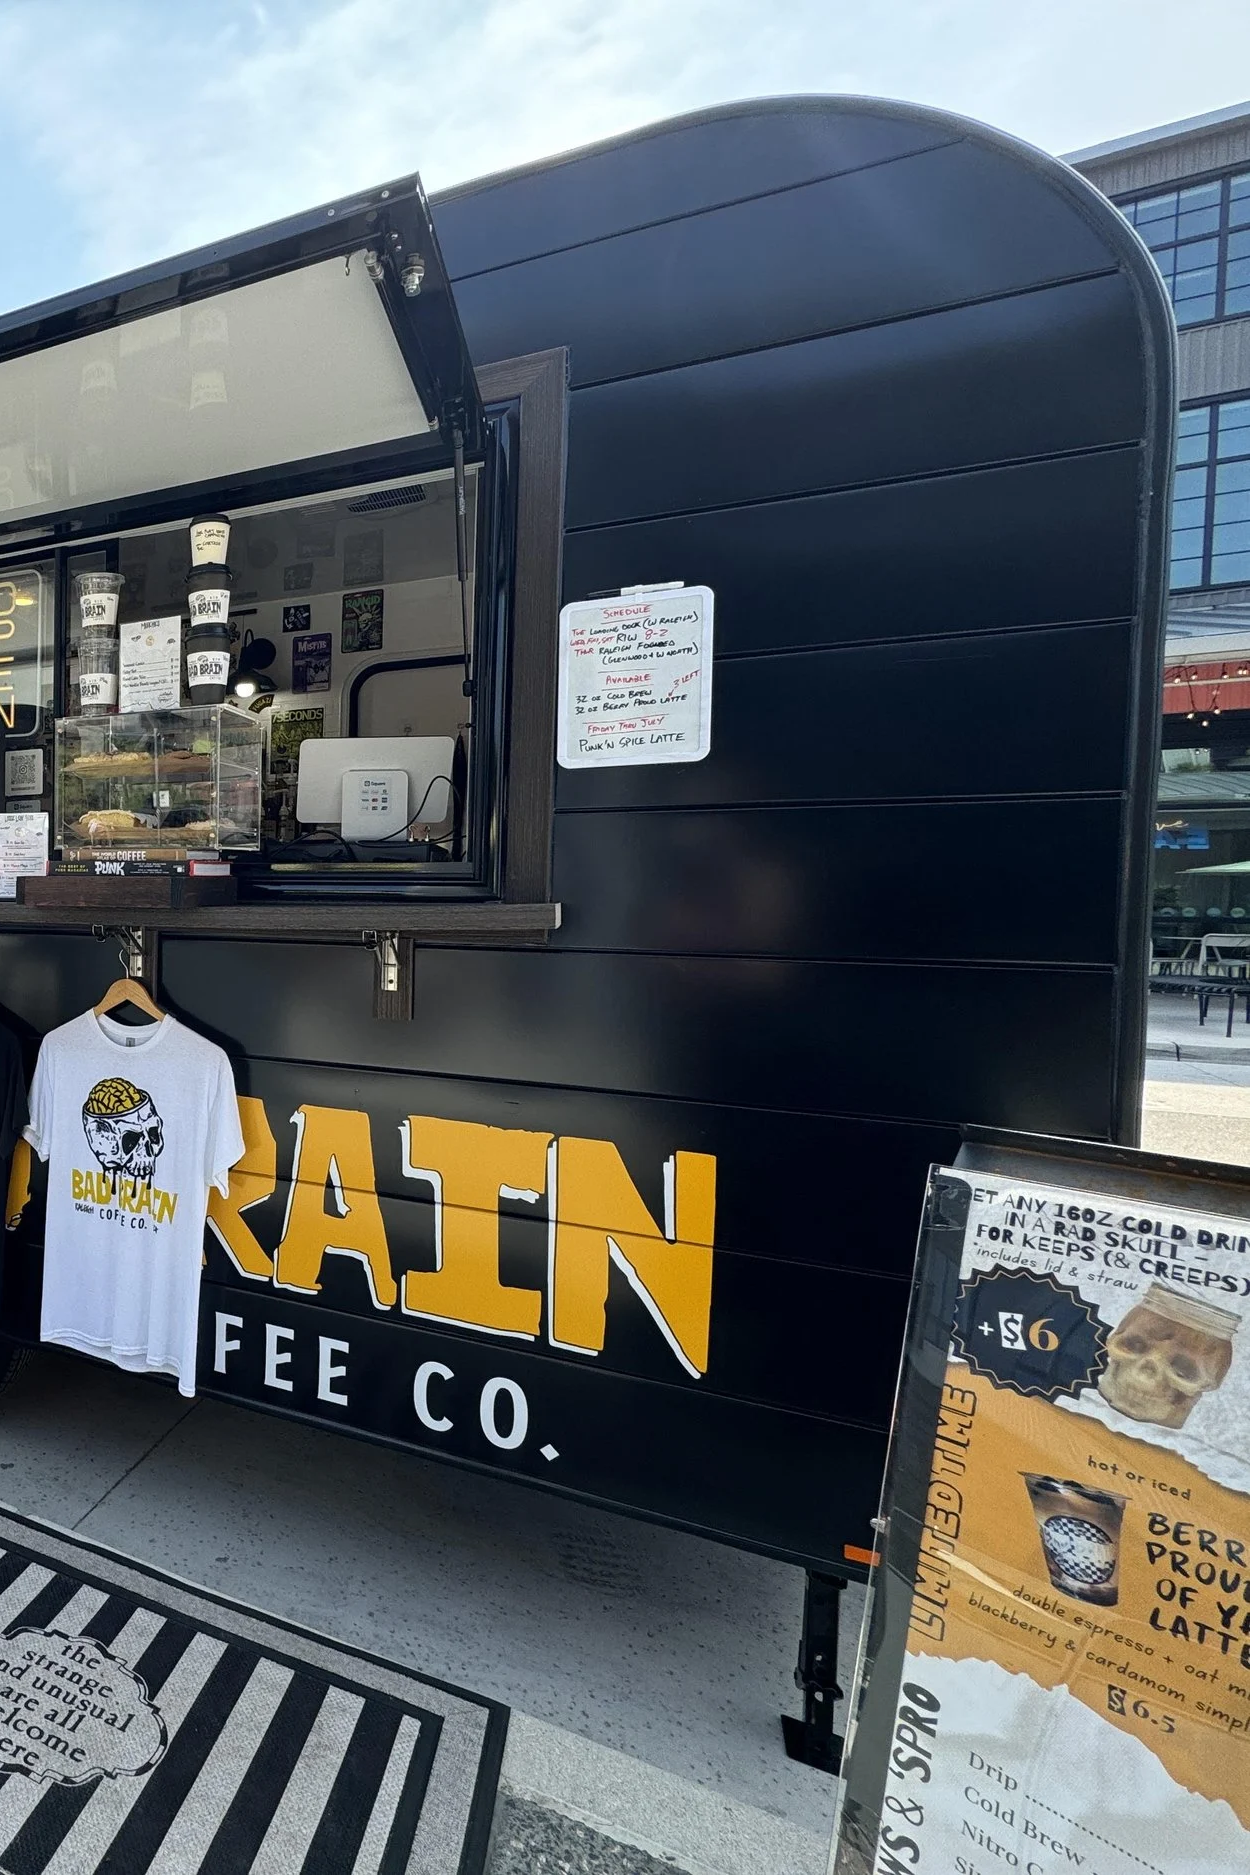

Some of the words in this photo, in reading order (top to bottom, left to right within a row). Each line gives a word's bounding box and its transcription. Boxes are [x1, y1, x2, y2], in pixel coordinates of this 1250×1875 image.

[85, 604, 106, 617] BRAIN
[198, 600, 222, 616] BRAIN
[345, 595, 381, 608] RANCID
[603, 604, 651, 619] SCHEDULE
[589, 626, 619, 636] LOADING
[621, 622, 641, 630] DOCK
[199, 663, 224, 677] BRAIN
[656, 650, 665, 658] W
[81, 684, 101, 696] BRAIN
[605, 673, 651, 685] AVAILABLE
[673, 678, 680, 689] 3
[681, 668, 701, 684] LEFT
[574, 706, 586, 715] 32
[602, 702, 630, 712] BERRY
[659, 693, 688, 704] LATTE
[576, 695, 589, 704] 32
[607, 692, 626, 700] COLD
[628, 689, 653, 699] BREW
[578, 738, 615, 753] PUNK'N
[618, 736, 646, 748] SPICE
[649, 732, 686, 744] LATTE
[587, 724, 616, 734] FRIDAY
[618, 721, 637, 730] THRU
[94, 861, 126, 876] PUNK
[117, 851, 147, 861] COFFEE
[71, 1168, 113, 1206] BAD
[118, 1176, 179, 1225] BRAIN
[99, 1208, 125, 1227] COFE
[130, 1217, 148, 1230] CO.
[971, 1188, 999, 1204] ET
[1002, 1193, 1047, 1214] ANY
[1121, 1215, 1188, 1241] COLD
[1196, 1229, 1250, 1254] DRIN
[203, 1096, 720, 1379] RAIN
[1004, 1211, 1026, 1229] IN
[1032, 1216, 1045, 1233] A
[1053, 1221, 1097, 1242] RAD
[1103, 1231, 1185, 1262] SKULL
[976, 1223, 1014, 1245] FOR
[1022, 1235, 1095, 1262] KEEPS
[1138, 1257, 1250, 1297] CREEPS)
[1044, 1257, 1064, 1274] lid
[1068, 1266, 1078, 1278] &
[1086, 1270, 1139, 1291] straw
[213, 1312, 350, 1406] FEE
[413, 1360, 560, 1461] CO.
[1087, 1455, 1119, 1476] hot
[1125, 1470, 1146, 1485] or
[1152, 1479, 1191, 1501] iced
[1146, 1511, 1247, 1568] BERR
[1155, 1578, 1199, 1609] OF
[1012, 1584, 1066, 1619] double
[1073, 1614, 1155, 1657] espresso
[1163, 1653, 1174, 1665] +
[1184, 1664, 1220, 1684] oat
[60, 1643, 102, 1671] the
[968, 1592, 1059, 1649] blackberry
[1064, 1639, 1076, 1653] &
[1086, 1650, 1186, 1702] cardamom
[1195, 1699, 1250, 1733] simpl
[21, 1649, 114, 1699] strange
[0, 1684, 40, 1712] are
[43, 1708, 87, 1734] all
[31, 1676, 136, 1733] unusual
[889, 1682, 941, 1784] 'SPRO
[968, 1751, 1018, 1792] Drip
[885, 1795, 924, 1827] &
[964, 1786, 1015, 1828] Cold
[1022, 1818, 1087, 1867] Brew
[877, 1825, 920, 1875] WS
[961, 1819, 1019, 1867] Nitro
